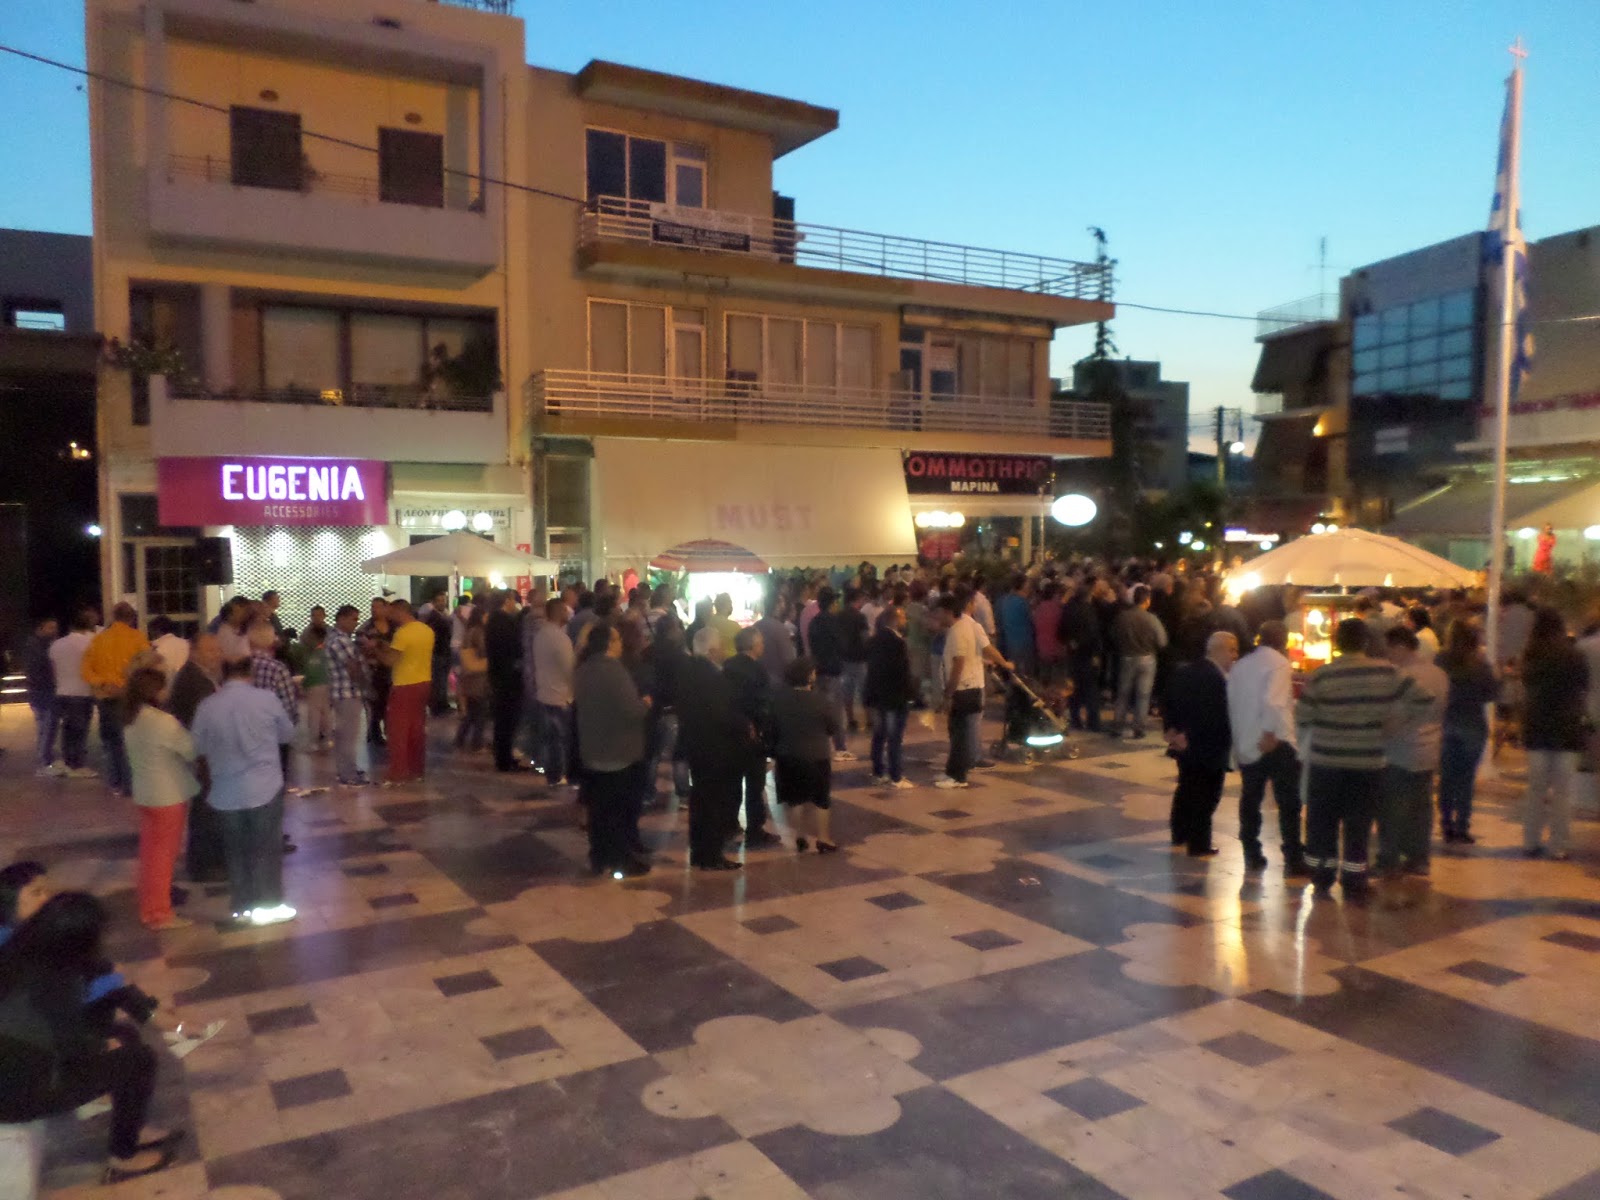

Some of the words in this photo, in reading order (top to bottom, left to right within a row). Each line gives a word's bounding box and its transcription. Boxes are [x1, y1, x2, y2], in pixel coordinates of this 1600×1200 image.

[221, 463, 366, 501] EUGENIA
[950, 480, 1000, 492] ΜΑΡΙΝΑ
[716, 504, 812, 530] MUST
